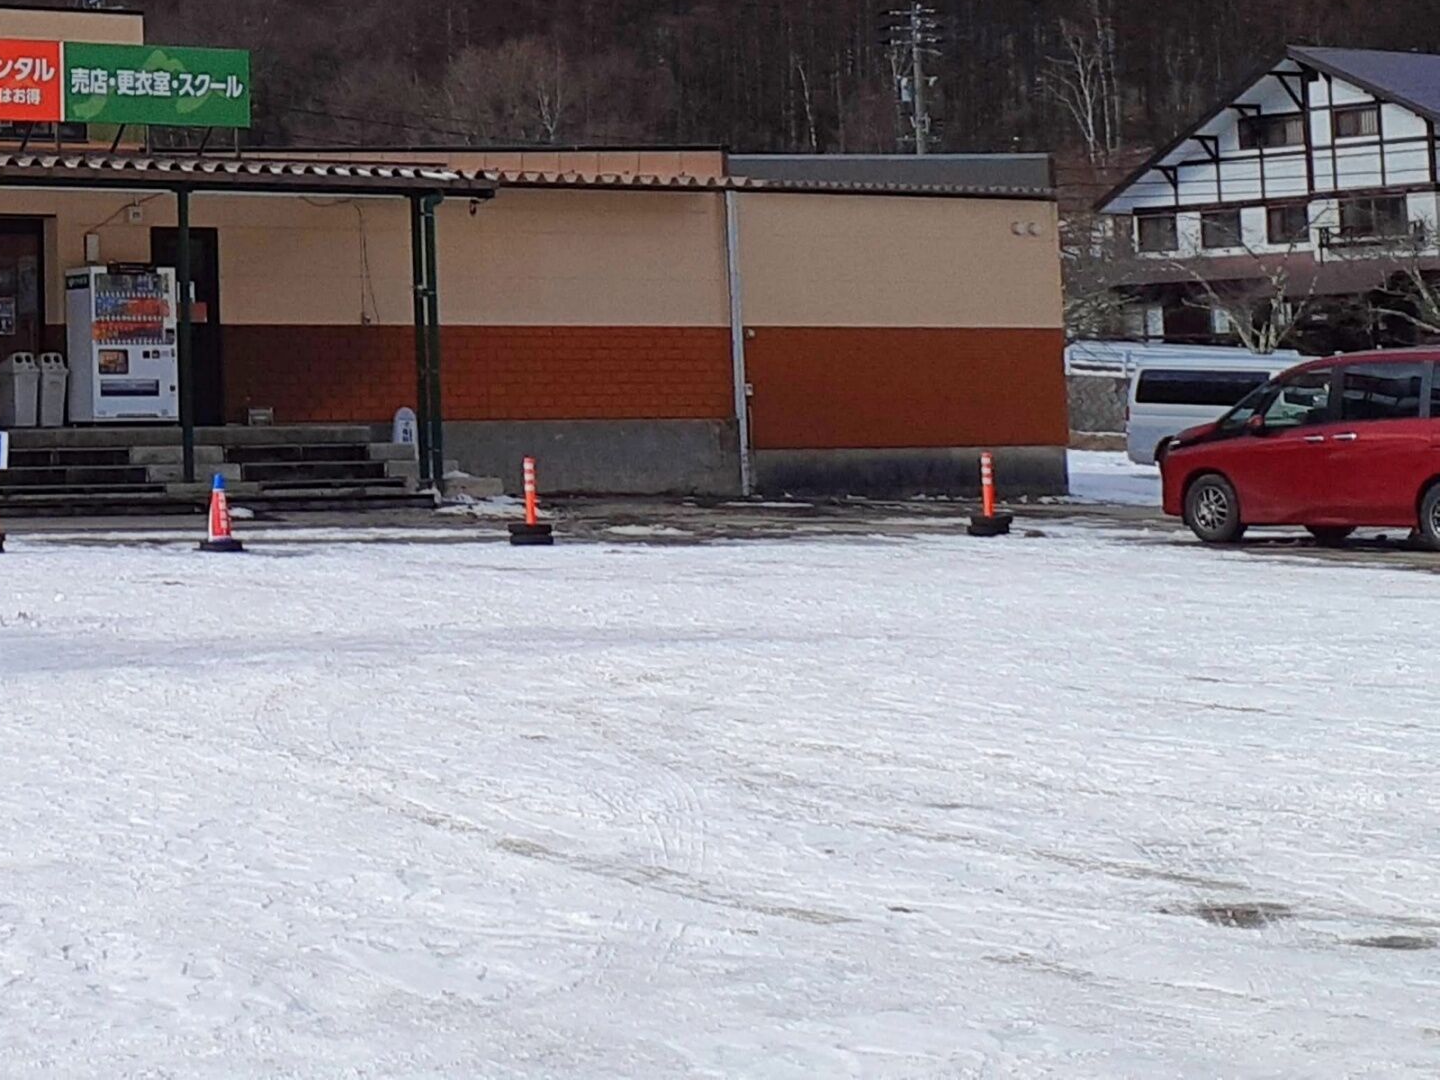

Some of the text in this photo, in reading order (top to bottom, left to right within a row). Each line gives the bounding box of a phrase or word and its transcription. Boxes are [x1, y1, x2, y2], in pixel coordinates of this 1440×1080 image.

[71, 68, 244, 99] 売店・更衣室・スクール
